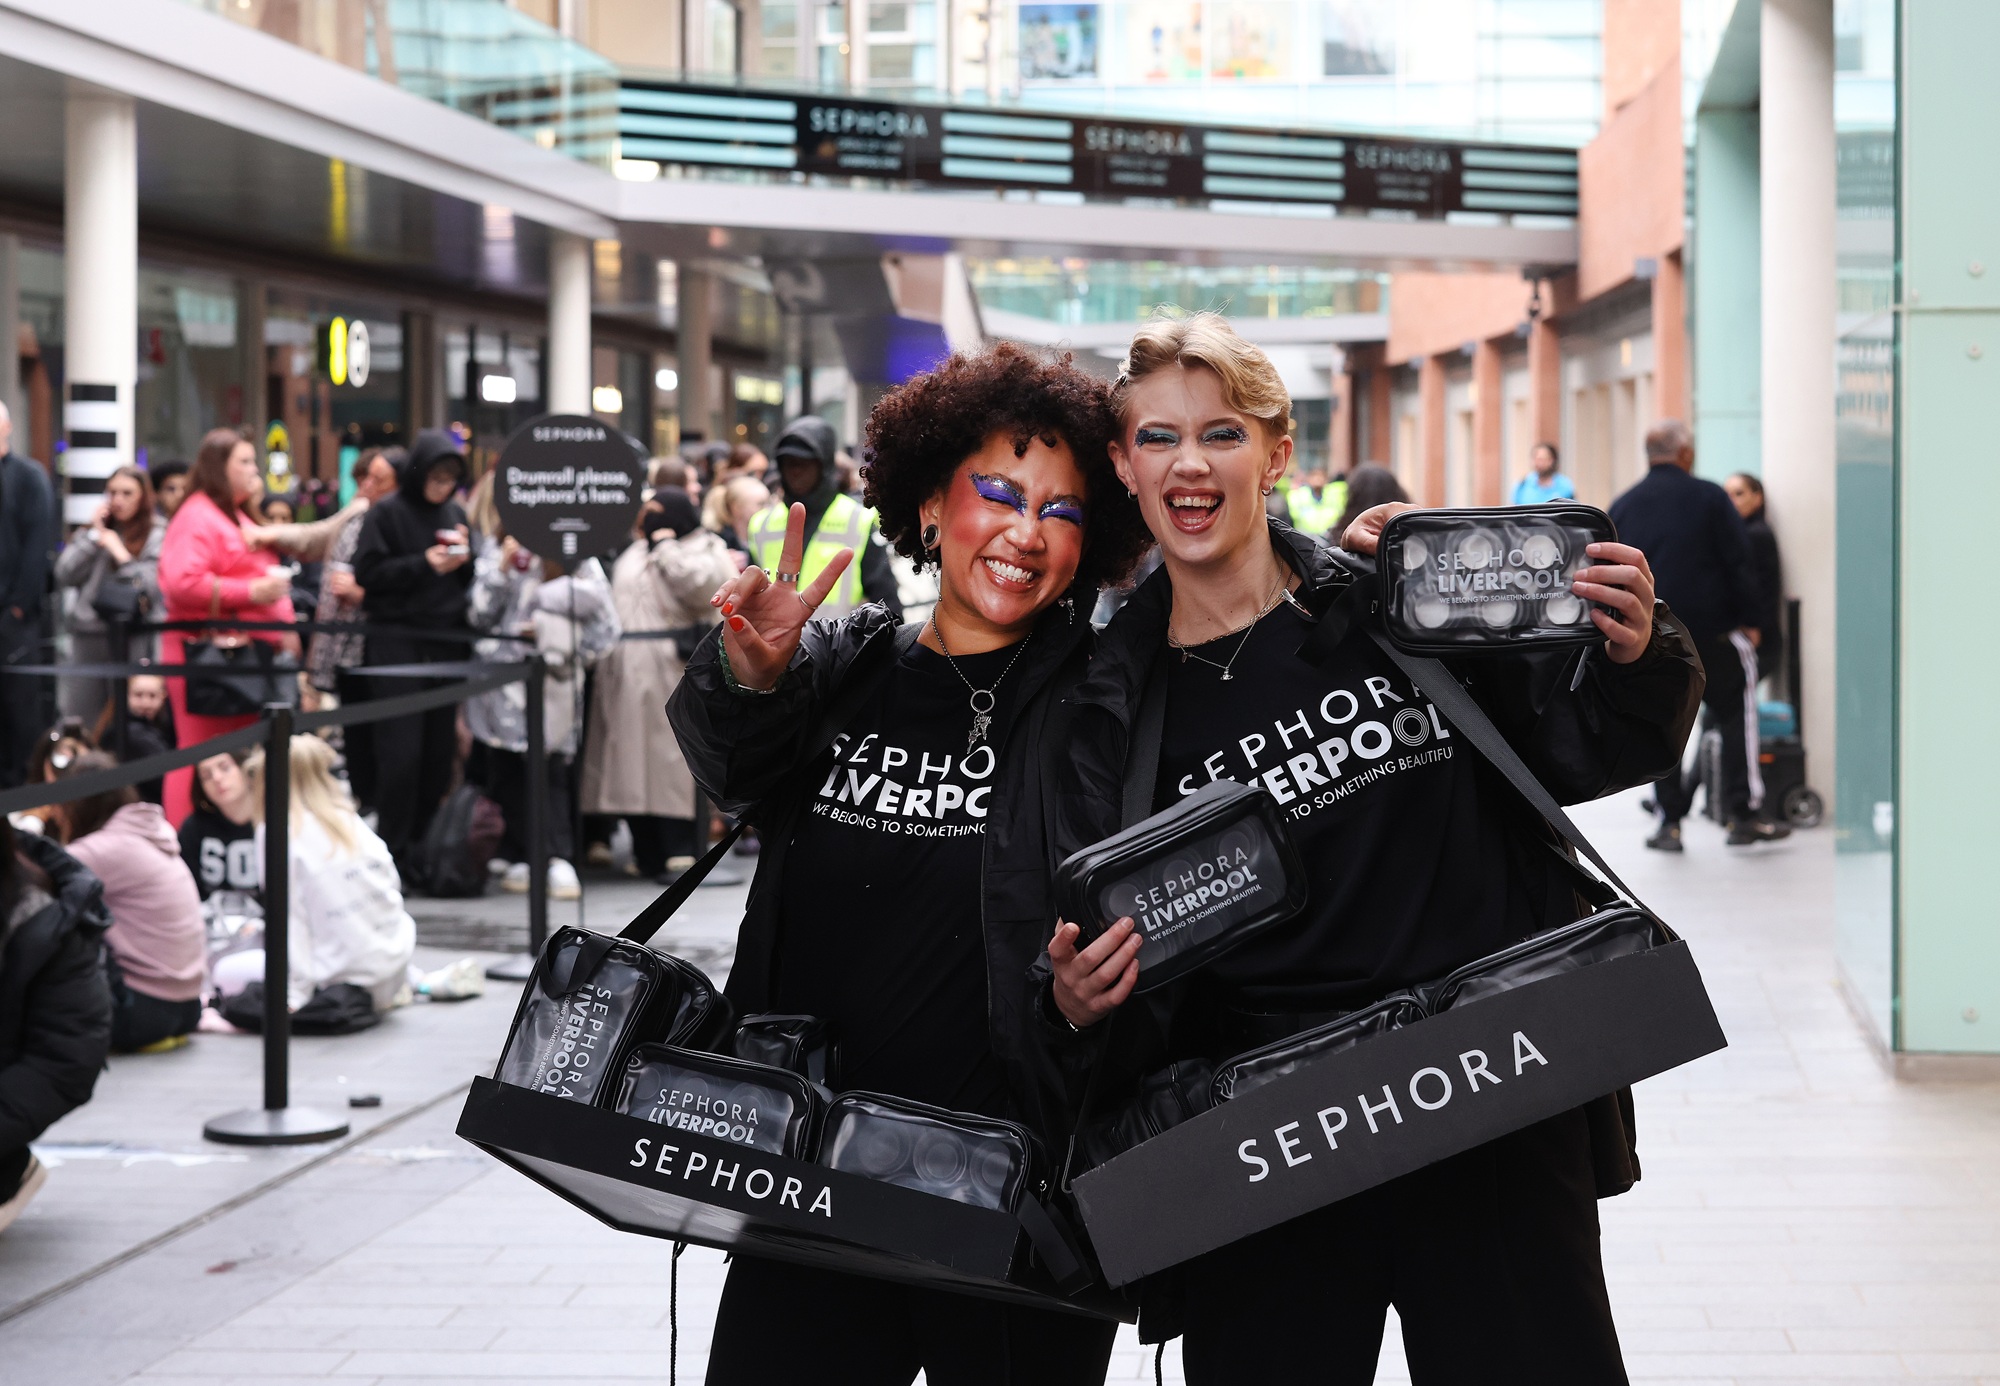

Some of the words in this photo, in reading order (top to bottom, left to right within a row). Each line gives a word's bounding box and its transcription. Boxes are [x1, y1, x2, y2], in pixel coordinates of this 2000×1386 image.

[809, 106, 929, 138] SEPHORA
[1084, 126, 1193, 157] SEPHORA
[1354, 144, 1452, 174] SEPHORA
[533, 426, 607, 442] SEPHORA
[506, 466, 575, 486] Drumroll
[575, 466, 632, 493] please,
[508, 485, 588, 508] Sephora's
[589, 486, 630, 504] here.
[1437, 547, 1565, 571] SEPHORA
[1438, 569, 1565, 593] LIVERPOOL
[1452, 596, 1479, 604] BELONG
[1490, 593, 1530, 602] SOMETHING
[1532, 591, 1565, 600] BEAUTIFUL
[831, 732, 995, 784] SEPHO
[1248, 703, 1450, 805] ERPOOL
[819, 765, 992, 819] LIVERPO
[1290, 803, 1311, 820] TO
[1314, 761, 1396, 810] SOMETHING
[812, 802, 830, 816] WE
[830, 807, 877, 829] BELONG
[881, 819, 900, 833] TO
[1134, 846, 1248, 912] SEPHORA
[1142, 865, 1258, 932] LIVERPOOL
[1150, 933, 1162, 942] WE
[1161, 920, 1187, 937] BELONG
[1186, 916, 1197, 925] TO
[1197, 897, 1232, 920] SOMETHING
[1232, 883, 1262, 902] BEAUTIFUL
[557, 1015, 565, 1024] TO
[561, 993, 572, 1015] ELONG
[540, 983, 595, 1093] LIVERPOOL
[543, 1025, 561, 1061] SOMETHING
[557, 987, 612, 1098] SEPHORA
[657, 1088, 759, 1125] SEPHORA
[1238, 1030, 1548, 1182] SEPHORA
[648, 1107, 755, 1145] LIVERPOOL
[630, 1138, 832, 1217] SEPHORA
